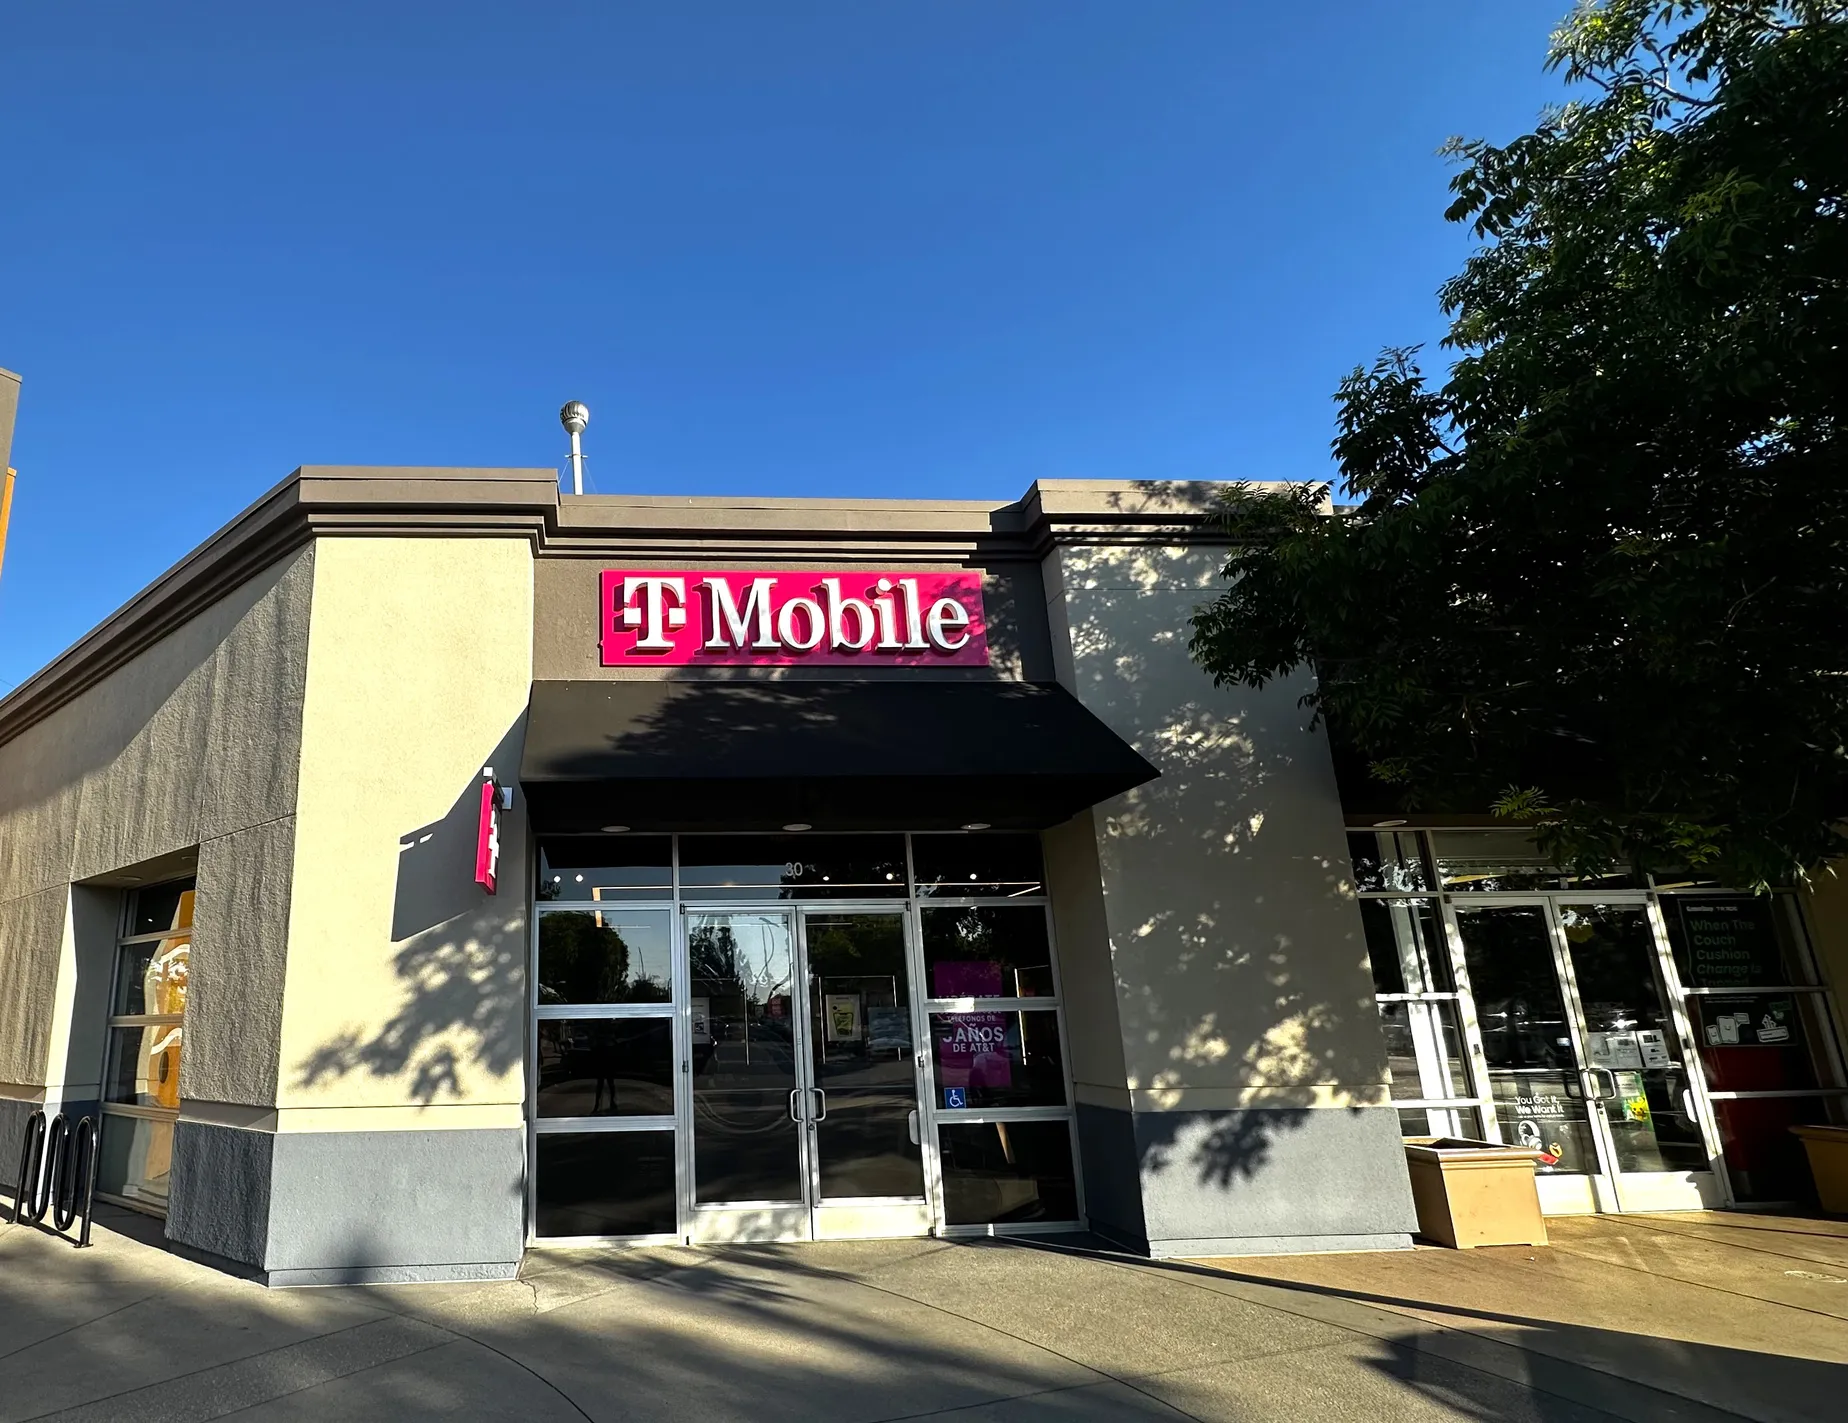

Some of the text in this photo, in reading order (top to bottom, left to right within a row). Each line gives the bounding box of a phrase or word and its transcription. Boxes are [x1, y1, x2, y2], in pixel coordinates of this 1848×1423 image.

[702, 577, 970, 652] Mobile
[785, 861, 803, 877] 30
[1690, 919, 1756, 931] When The
[1693, 934, 1736, 946] Couch
[1696, 949, 1750, 960] Cushion
[1696, 963, 1749, 977] Change
[955, 1022, 1004, 1042] AÑOS
[952, 1042, 995, 1053] DE AT&T
[1514, 1096, 1532, 1104] You
[1533, 1095, 1550, 1104] Got
[1515, 1105, 1531, 1114] We
[1532, 1104, 1557, 1114] Want
